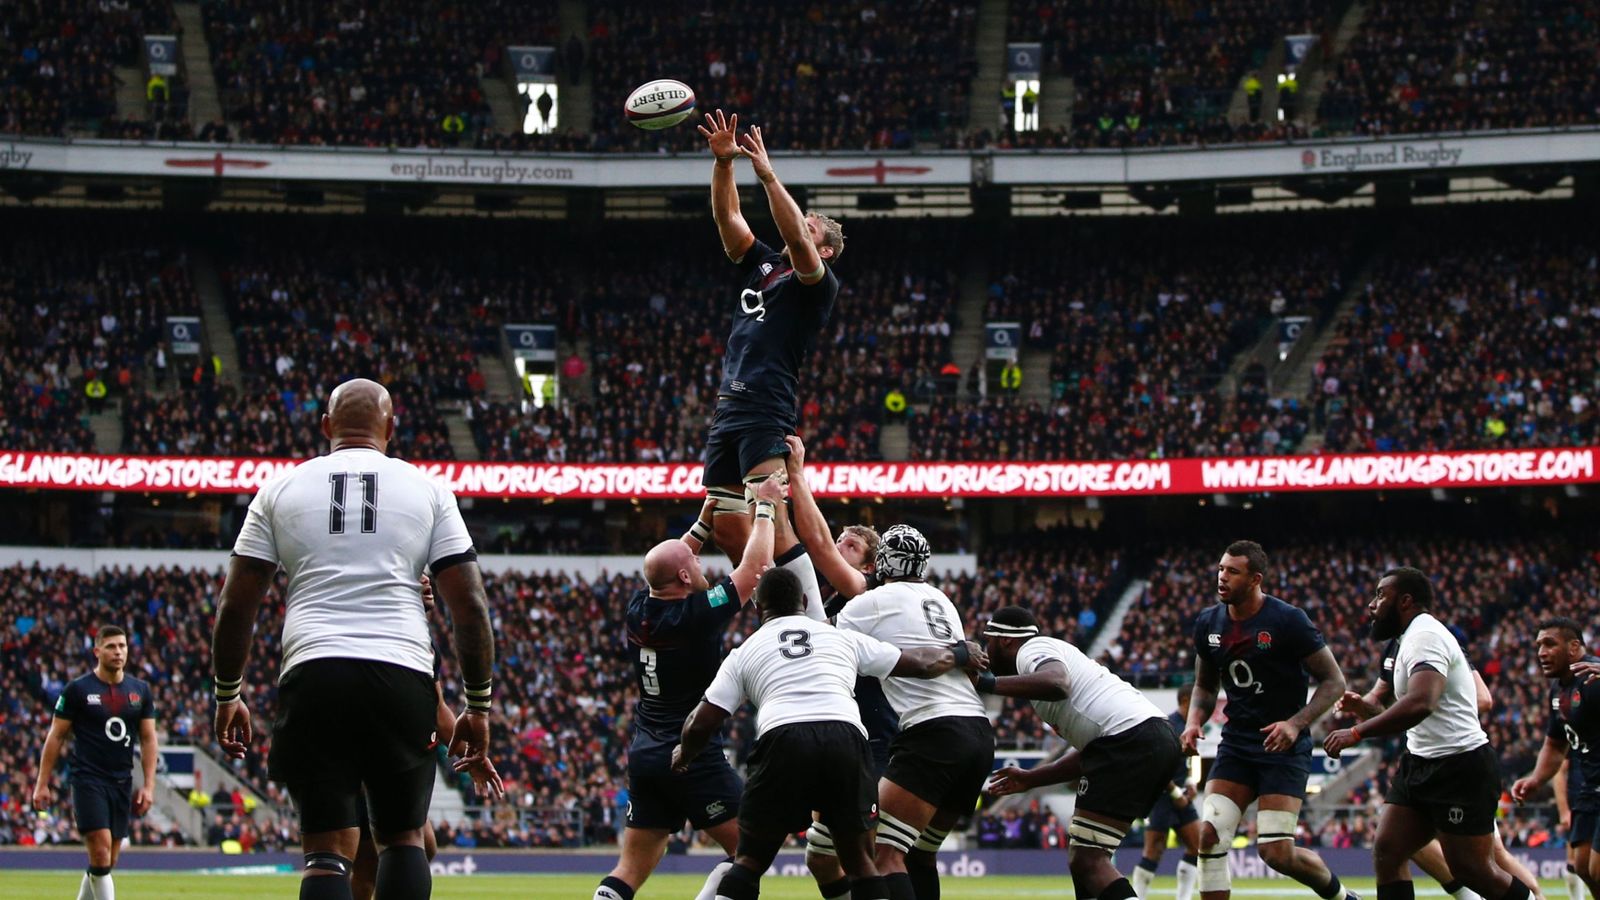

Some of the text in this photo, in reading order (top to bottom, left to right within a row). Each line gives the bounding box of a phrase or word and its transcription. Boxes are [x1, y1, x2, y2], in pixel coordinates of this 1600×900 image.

[632, 90, 687, 108] GILBERT
[390, 155, 573, 183] englandrugby.com
[1320, 142, 1463, 171] England Rugby
[1202, 450, 1593, 487] WWW.ENGLANDRUGBYSTORE.COM
[329, 472, 378, 534] 11
[921, 599, 952, 640] 6
[778, 628, 813, 660] 3
[639, 647, 661, 696] 3
[1229, 660, 1265, 694] O2
[104, 716, 131, 747] O2
